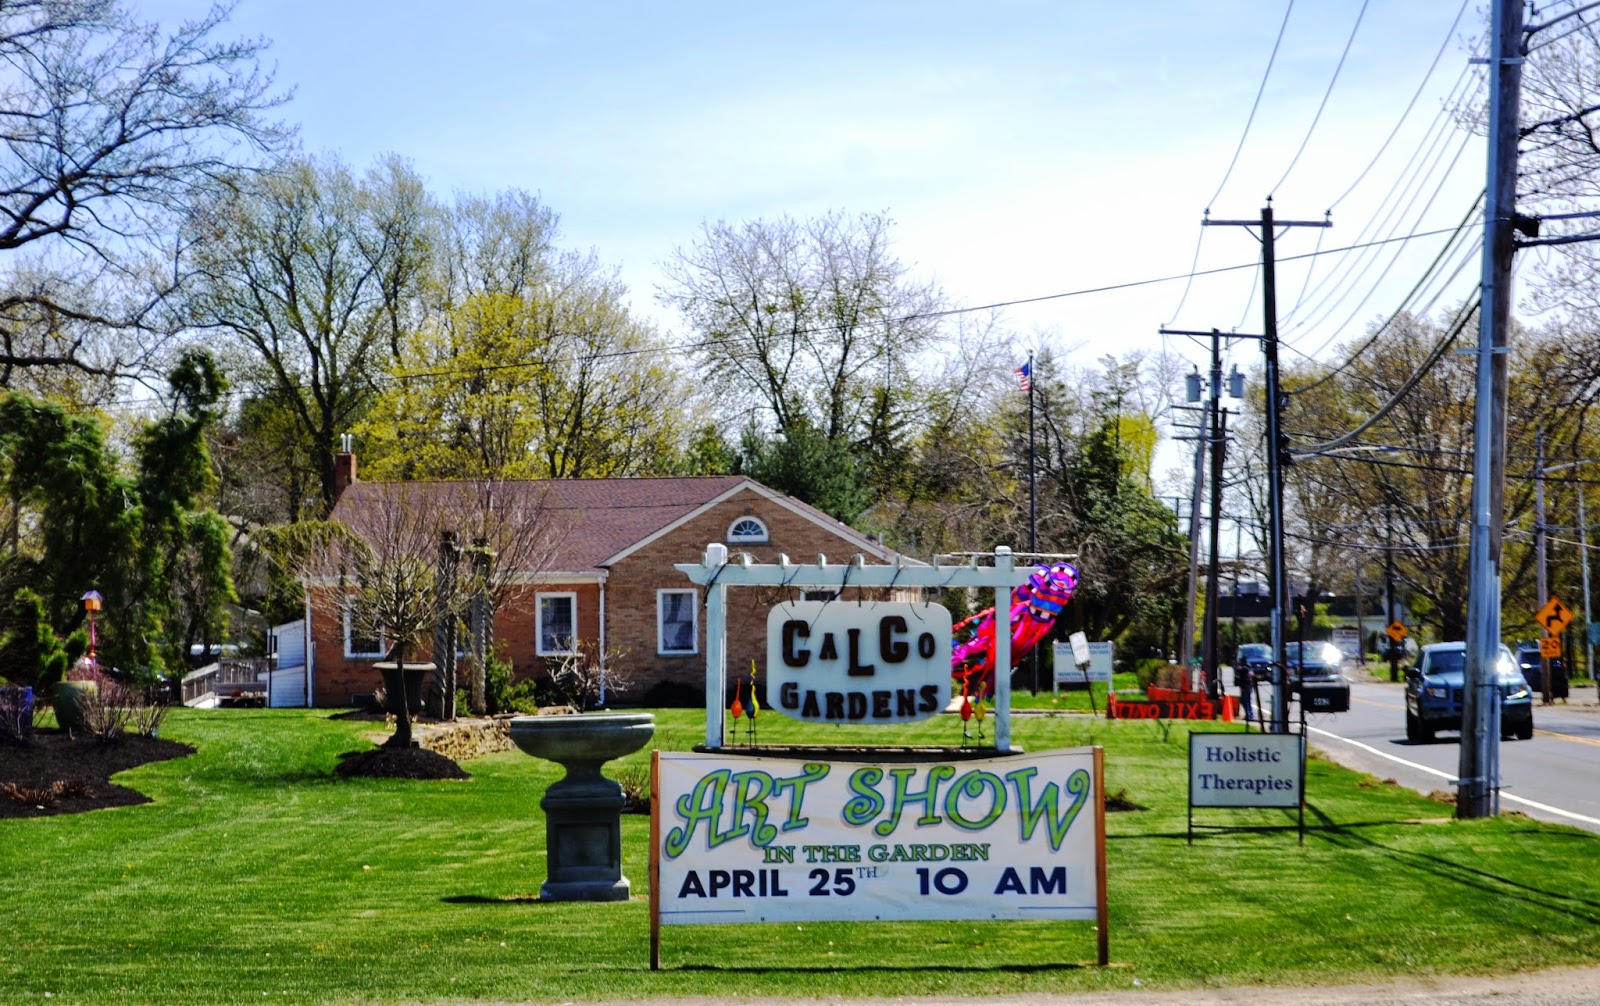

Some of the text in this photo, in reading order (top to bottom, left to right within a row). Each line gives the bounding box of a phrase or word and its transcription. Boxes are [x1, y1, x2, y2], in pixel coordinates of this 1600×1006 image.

[781, 682, 938, 719] GARDENS
[1205, 746, 1282, 763] Holistic
[1198, 773, 1294, 795] Therapies
[664, 763, 1091, 859] ART SHOW
[763, 843, 991, 863] IN THE GARDEN
[678, 869, 788, 898] APRIL
[916, 867, 969, 895] 10
[994, 866, 1067, 895] AM
